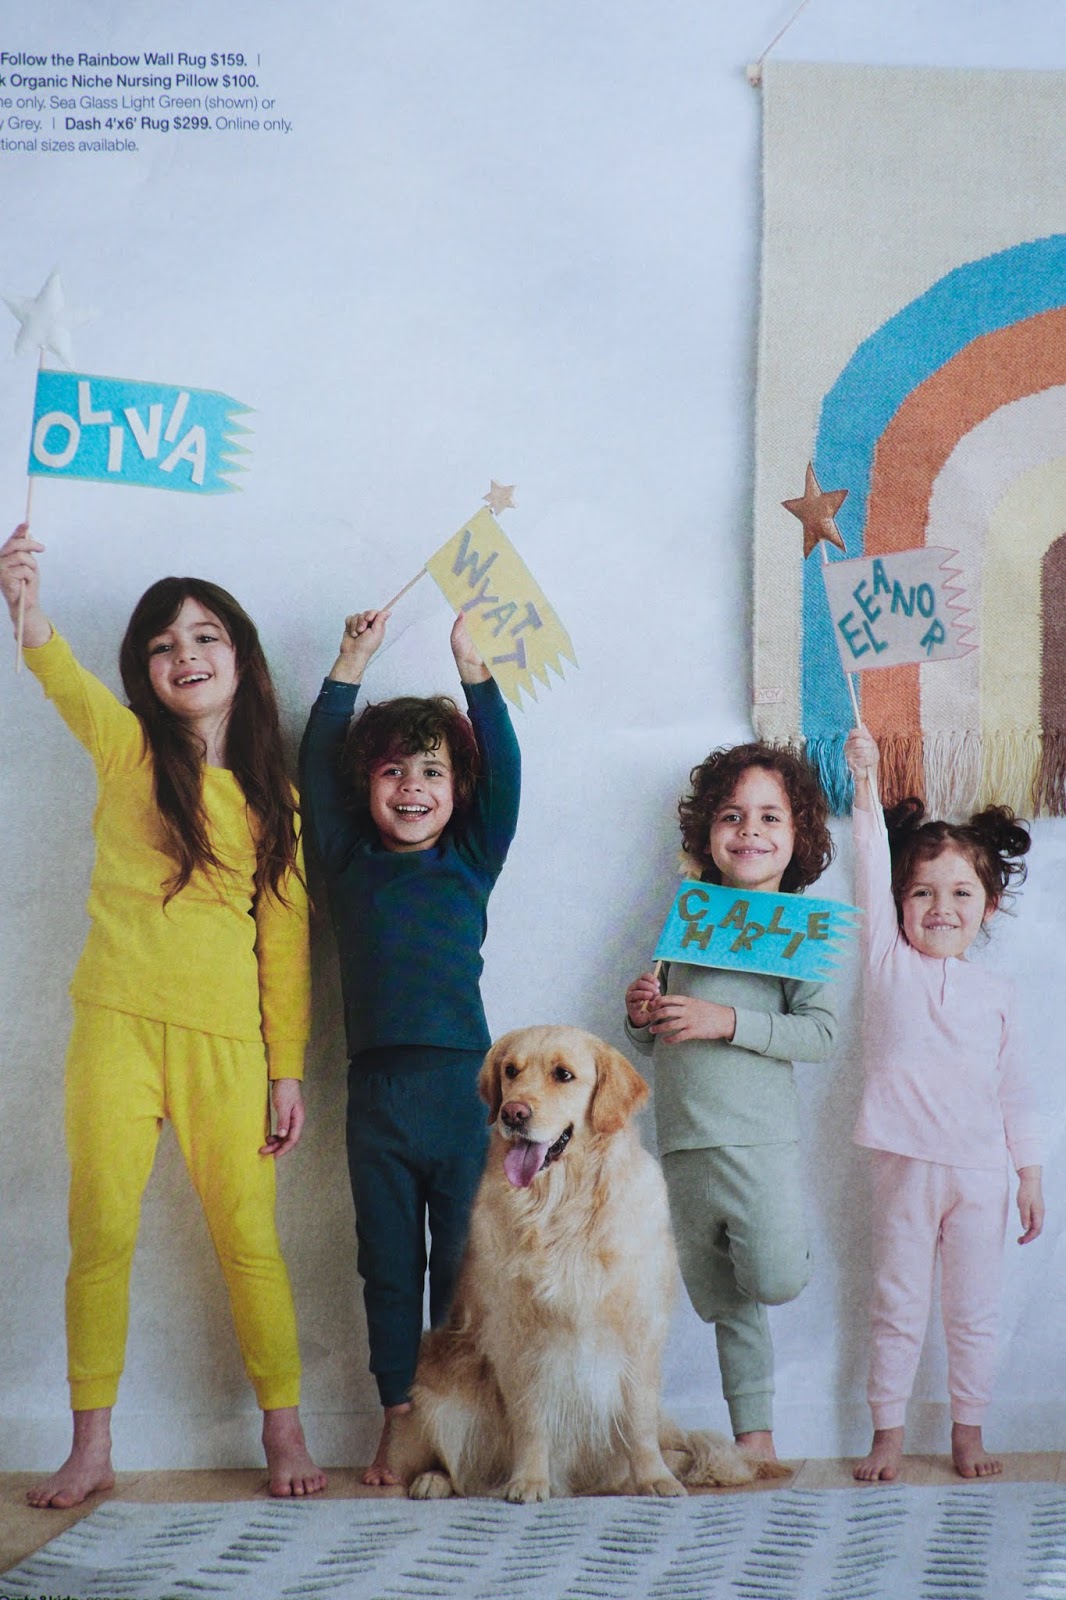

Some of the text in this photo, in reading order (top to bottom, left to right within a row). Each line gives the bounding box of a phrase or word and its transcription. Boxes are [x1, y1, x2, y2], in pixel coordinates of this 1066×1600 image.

[1, 52, 247, 69] Follow the Rainbow Wall Rug $159.
[10, 74, 68, 90] Organic
[72, 74, 113, 88] Niche
[117, 74, 172, 90] Nursing
[176, 74, 219, 88] Pillow
[222, 74, 259, 88] $100.
[16, 96, 46, 112] only.
[50, 95, 76, 109] Sea
[80, 95, 118, 109] Glass
[122, 95, 155, 111] Light
[158, 95, 201, 109] Green
[205, 95, 258, 112] (shown)
[261, 98, 276, 109] or
[8, 116, 42, 133] Grey.
[65, 117, 101, 130] Dash
[141, 116, 169, 133] Rug
[173, 116, 212, 130] $299.
[216, 116, 260, 130] Online
[263, 118, 293, 134] only.
[1, 138, 139, 152] tional sizes available.
[33, 381, 207, 486] OLIVIA
[451, 529, 544, 670] WYATT
